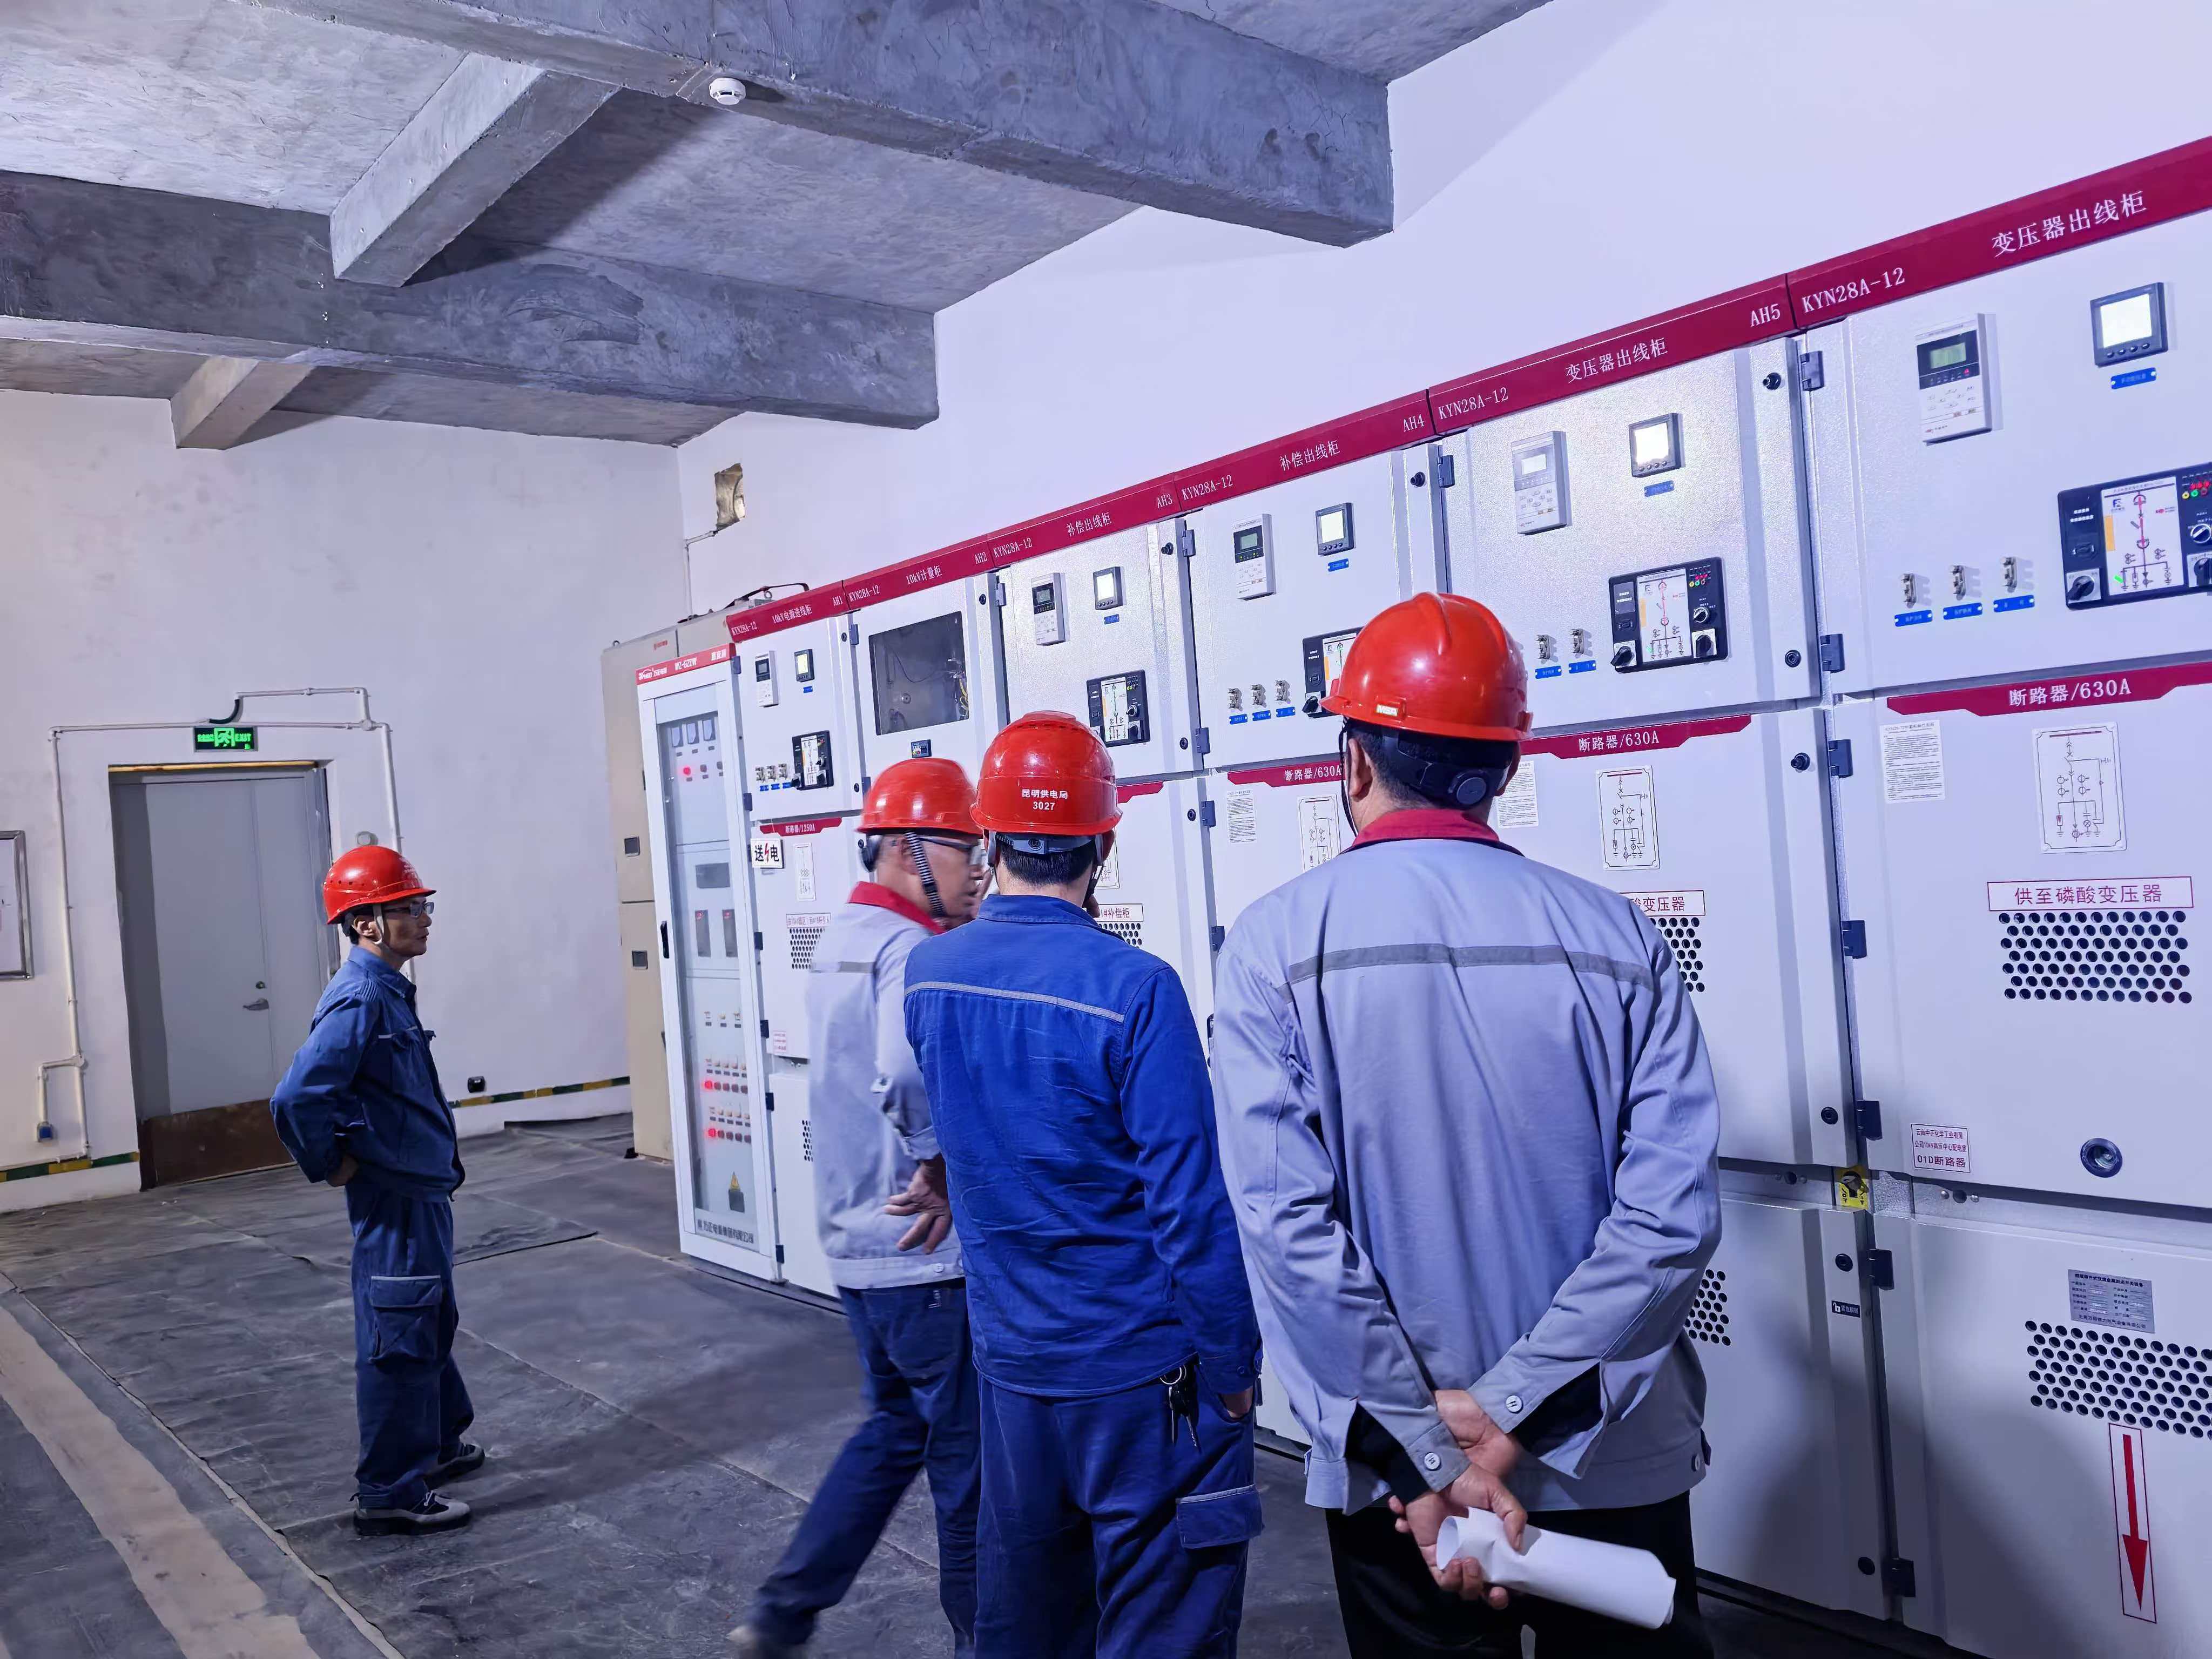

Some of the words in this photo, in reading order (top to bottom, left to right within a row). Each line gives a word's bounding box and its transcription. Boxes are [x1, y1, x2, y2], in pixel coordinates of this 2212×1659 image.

[1992, 191, 2148, 258] 变压器出线柜
[1802, 266, 1906, 314] KYN28A-12
[1750, 304, 1781, 327] AH5
[1566, 338, 1668, 383] 变压器出线柜
[1438, 387, 1509, 420] KYN28A-12
[1404, 414, 1425, 432] AH4
[1279, 439, 1341, 471] 补偿出线柜
[1182, 474, 1233, 501] KYN28A-12
[1157, 493, 1173, 509] AH3
[1066, 512, 1111, 537] 补偿出线柜
[993, 537, 1033, 558] KYN28A-12
[974, 551, 988, 565] AH2
[906, 565, 942, 585] 10kV计量柜
[832, 596, 843, 607] AH1
[848, 585, 880, 602] KYN28A-12
[772, 604, 813, 624] 10kV电源进线柜
[2009, 678, 2132, 706] 断路器/630A
[1578, 732, 1660, 752] 断路器/630A
[1285, 765, 1342, 782] 断路器/630A
[1022, 789, 1068, 799] 昆明供电局
[1033, 801, 1055, 811] 3027
[2014, 883, 2162, 906] 供至磷酸变压器
[1917, 1155, 1966, 1168] 01D断路器
